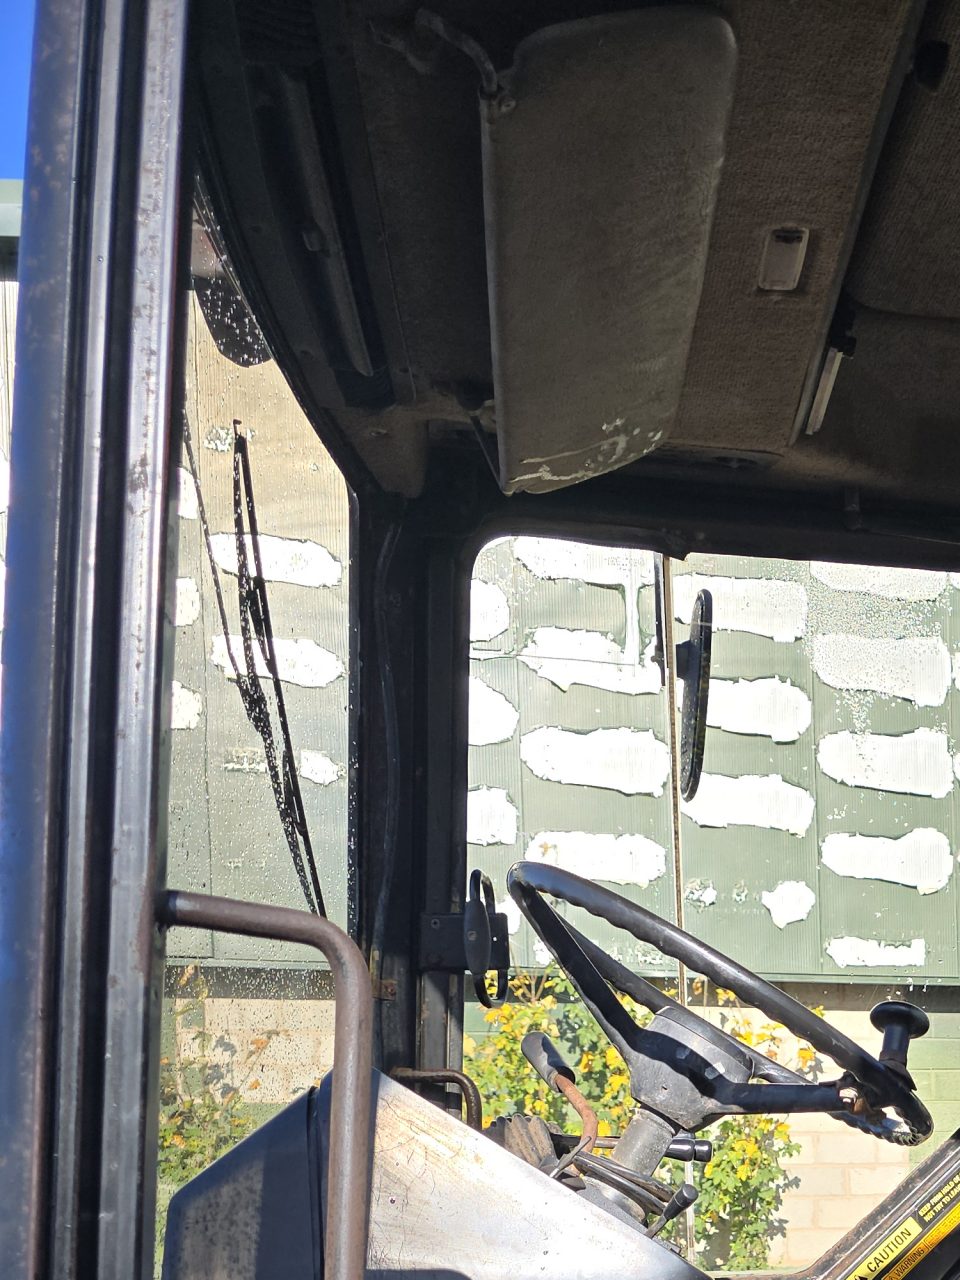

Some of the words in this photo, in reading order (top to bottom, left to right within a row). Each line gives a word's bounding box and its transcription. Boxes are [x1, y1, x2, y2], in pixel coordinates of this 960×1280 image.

[919, 1203, 931, 1216] KEEP
[941, 1181, 954, 1194] HOLD
[953, 1175, 960, 1183] OF
[924, 1210, 935, 1222] NOT
[934, 1202, 944, 1212] TRY
[942, 1196, 950, 1204] TO
[866, 1226, 912, 1274] CAUTION
[894, 1247, 926, 1278] WARNING
